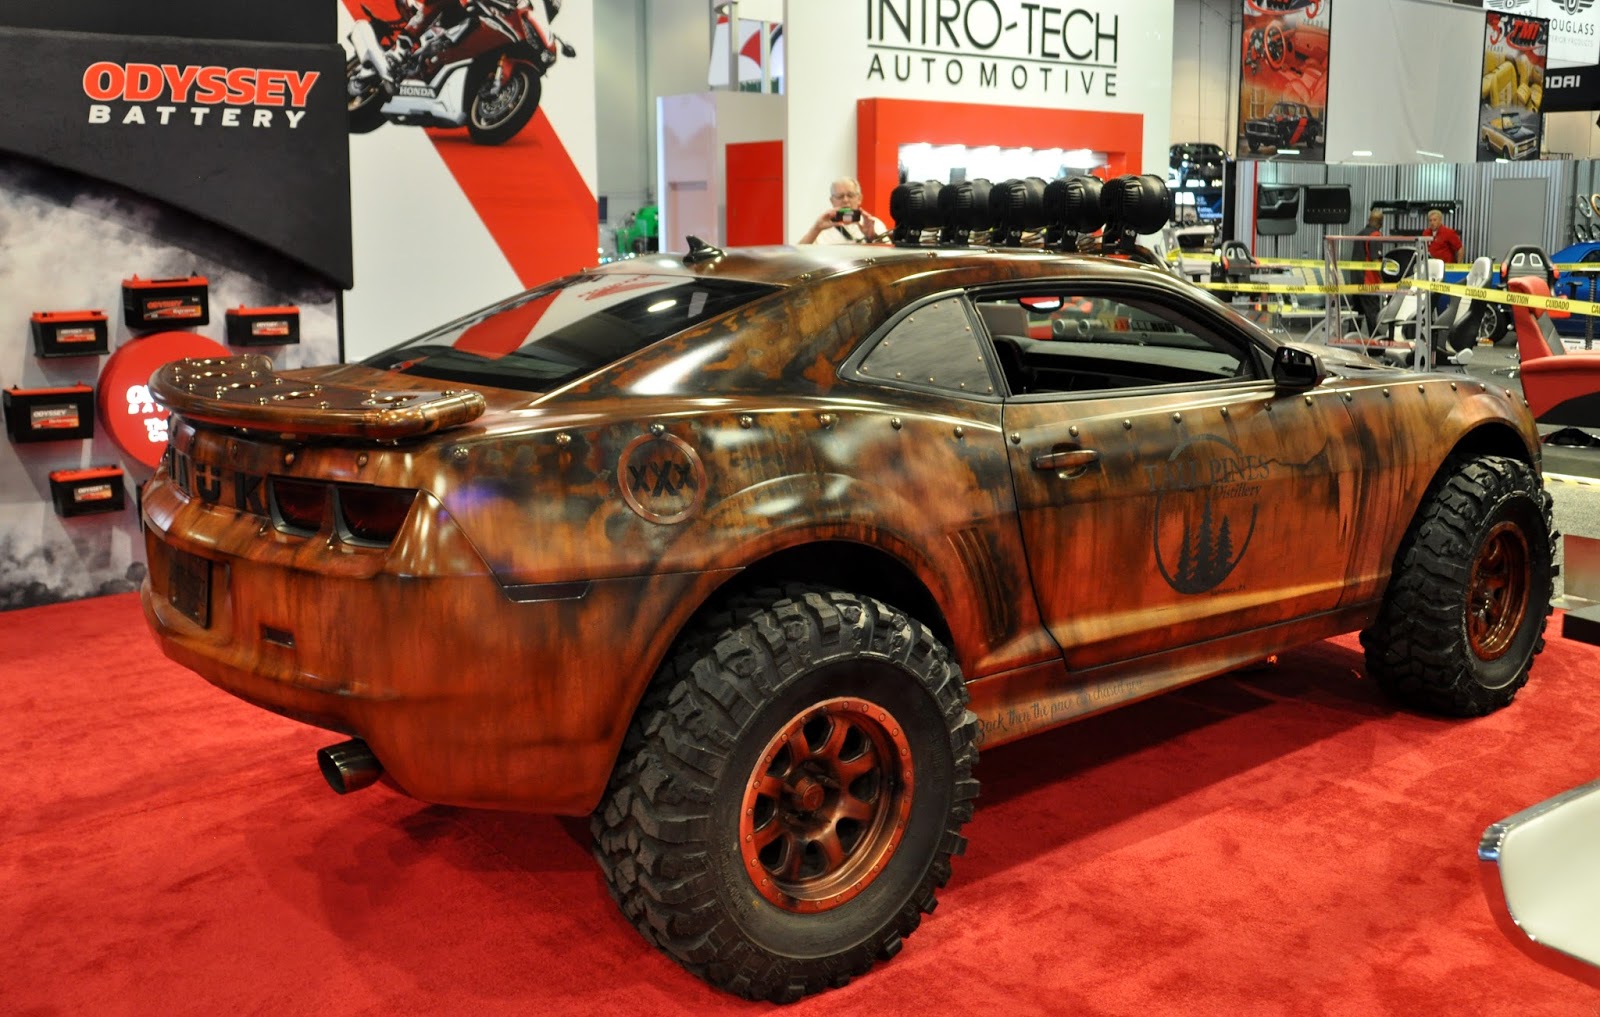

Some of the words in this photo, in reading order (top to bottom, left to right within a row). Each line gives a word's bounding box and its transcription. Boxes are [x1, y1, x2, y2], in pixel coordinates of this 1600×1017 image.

[1511, 20, 1541, 41] TMI
[1551, 18, 1595, 36] OUGLASS
[83, 61, 321, 107] ODYSSEY
[867, 53, 1117, 97] AUTOMOTIVE
[400, 85, 436, 98] HONDA
[88, 104, 306, 128] BATTERY
[1429, 283, 1451, 292] CAUTION
[1465, 288, 1487, 298] CUIDADO
[1506, 294, 1529, 304] CAUTION
[1545, 299, 1569, 310] CUIDADO
[33, 409, 67, 418] ODYSSEY
[628, 461, 697, 497] XXX
[1209, 454, 1270, 486] PINES
[1214, 482, 1262, 499] Distillery
